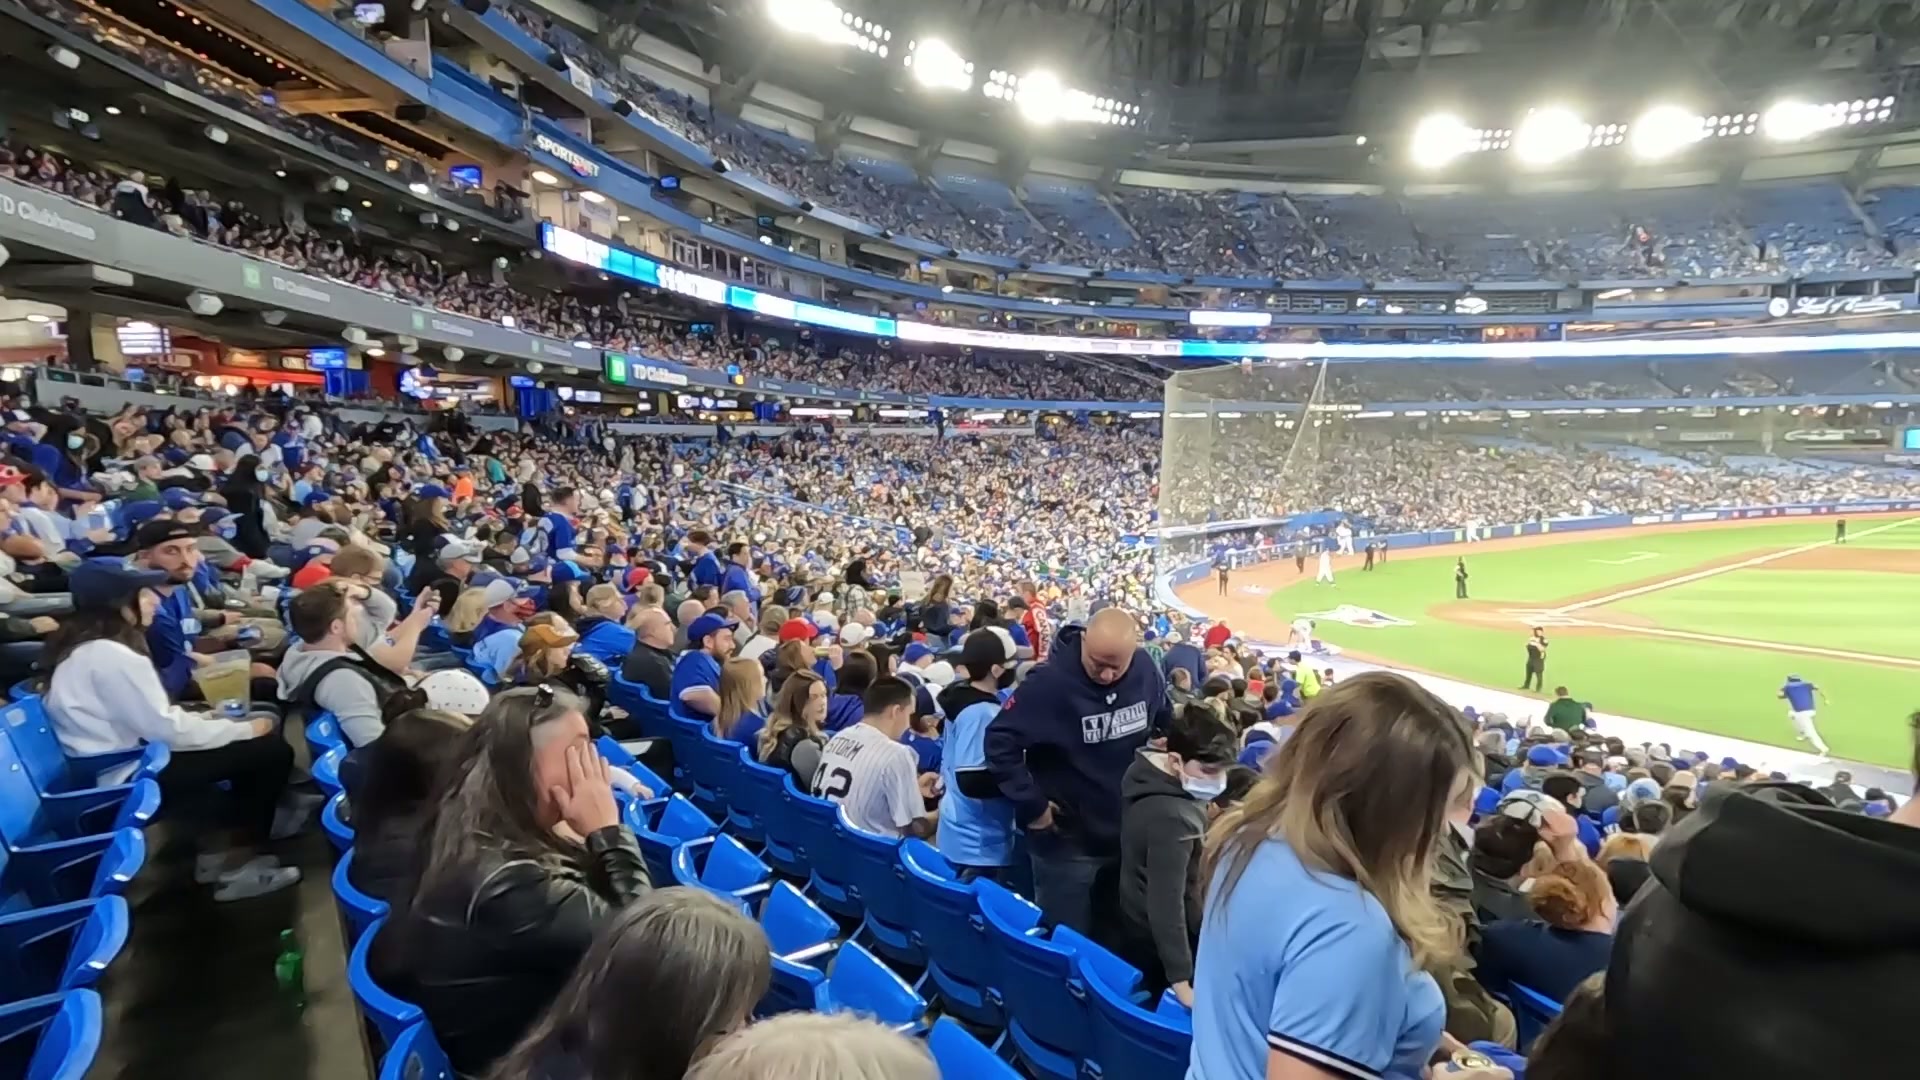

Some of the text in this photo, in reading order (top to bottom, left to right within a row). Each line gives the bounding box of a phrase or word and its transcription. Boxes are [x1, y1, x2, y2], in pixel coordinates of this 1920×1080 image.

[536, 133, 600, 177] SPORTSNET
[825, 737, 864, 761] STORM
[812, 762, 853, 801] 42
